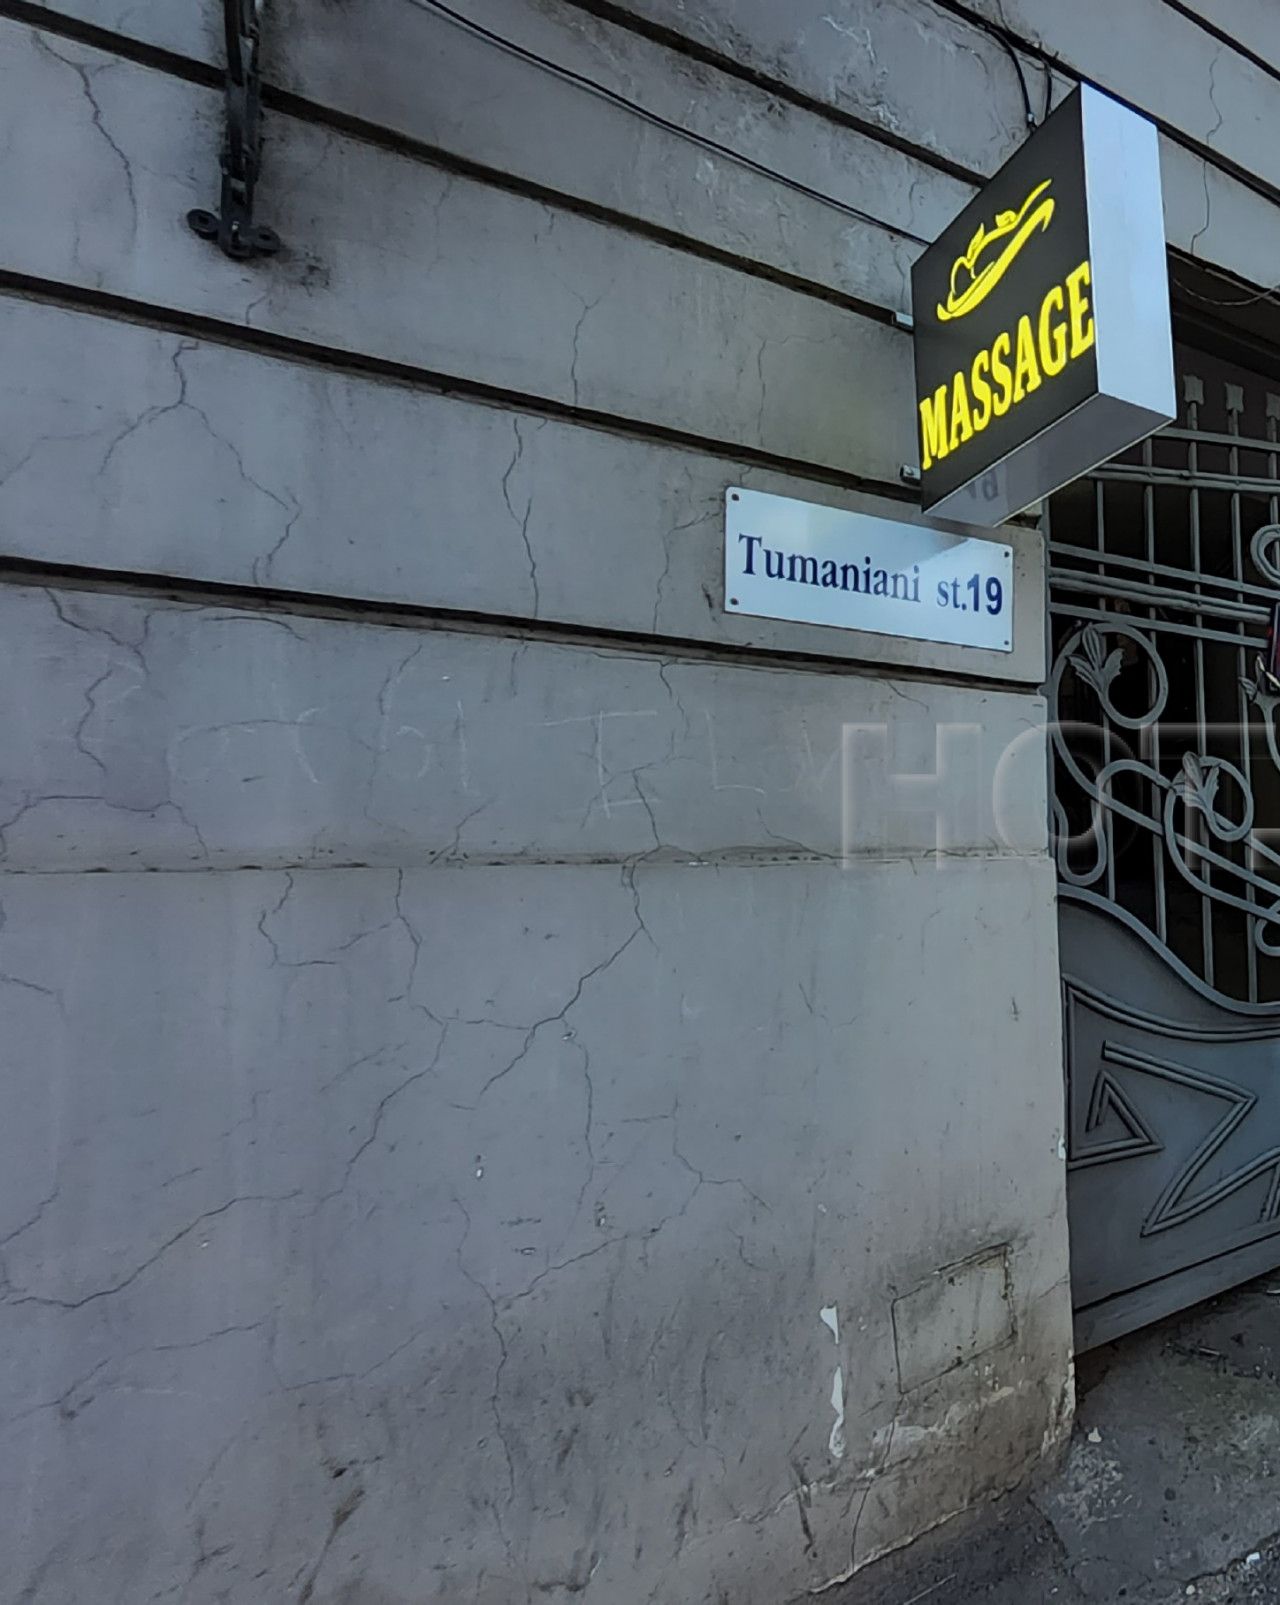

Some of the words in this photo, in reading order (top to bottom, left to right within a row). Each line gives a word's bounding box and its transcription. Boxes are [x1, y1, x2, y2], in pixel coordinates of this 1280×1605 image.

[919, 260, 1095, 471] MASSAGE
[738, 532, 921, 603] Tumaniani
[936, 573, 1003, 616] st.19
